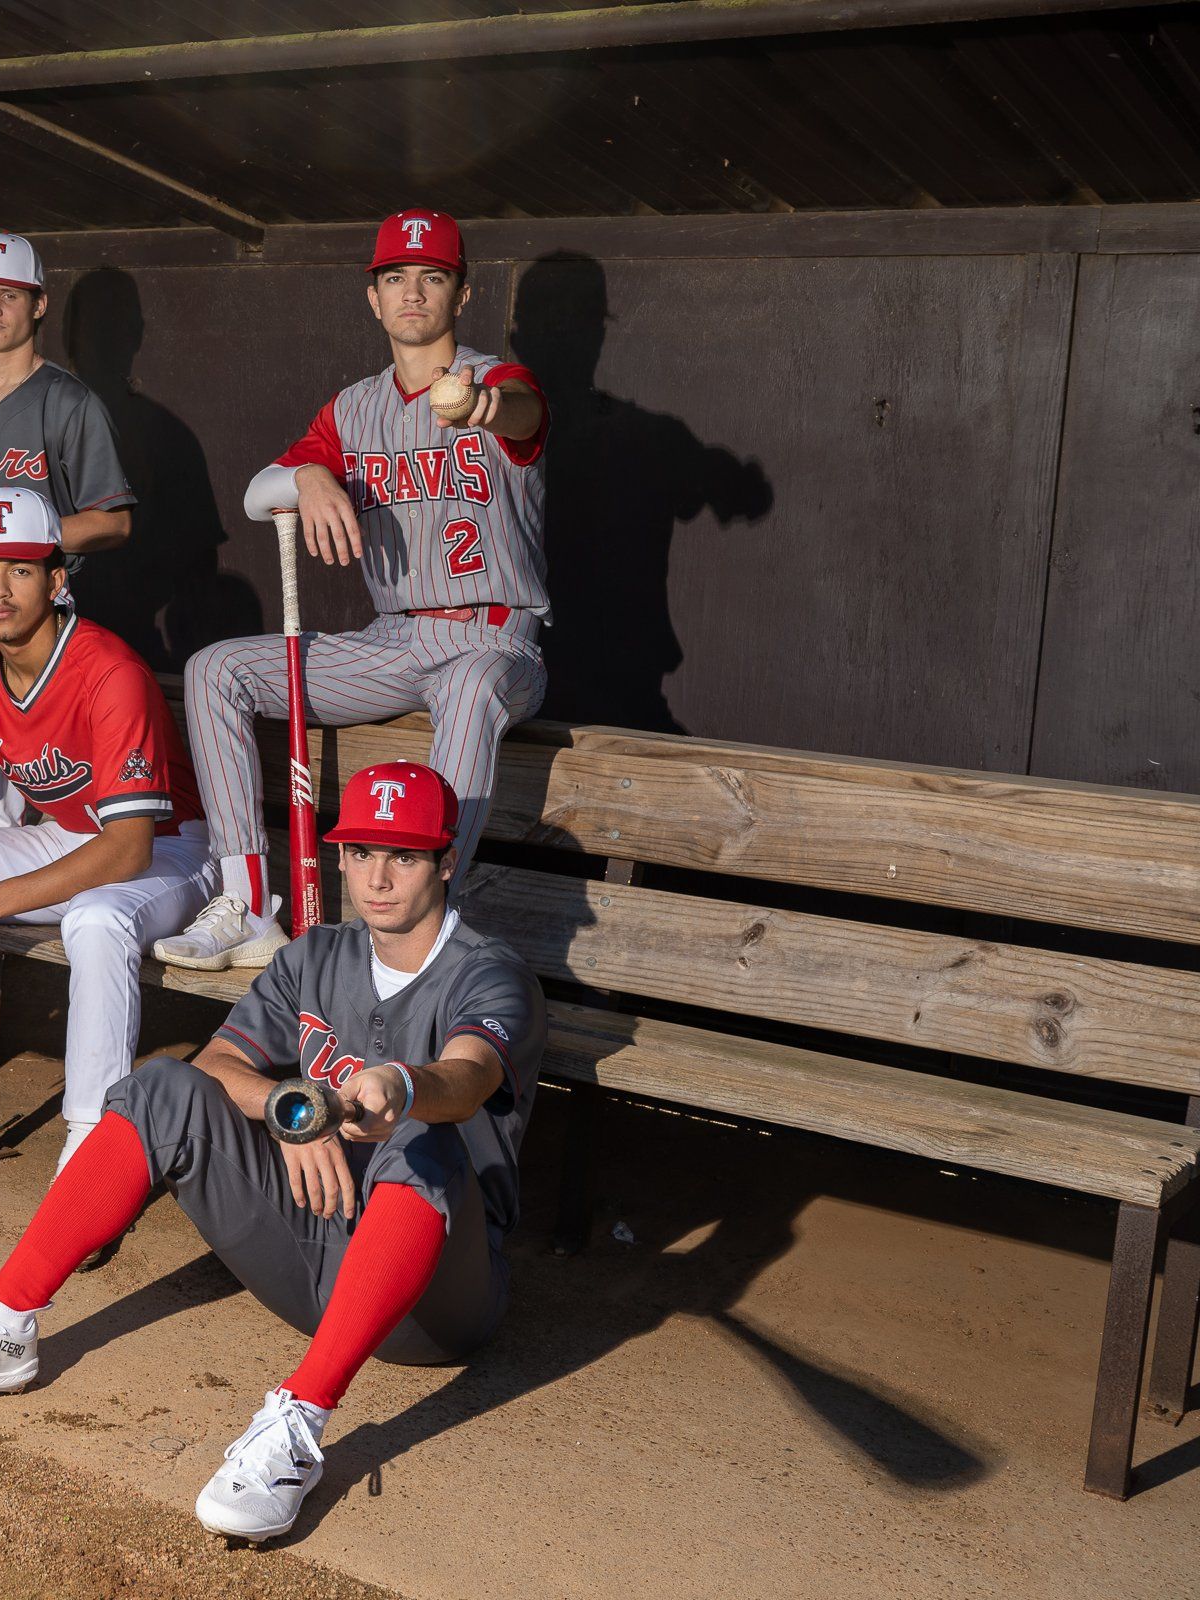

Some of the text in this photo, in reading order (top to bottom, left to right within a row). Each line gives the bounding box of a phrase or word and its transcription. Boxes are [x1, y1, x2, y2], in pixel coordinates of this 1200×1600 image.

[402, 217, 432, 249] T
[441, 516, 488, 580] 2
[370, 780, 406, 821] T
